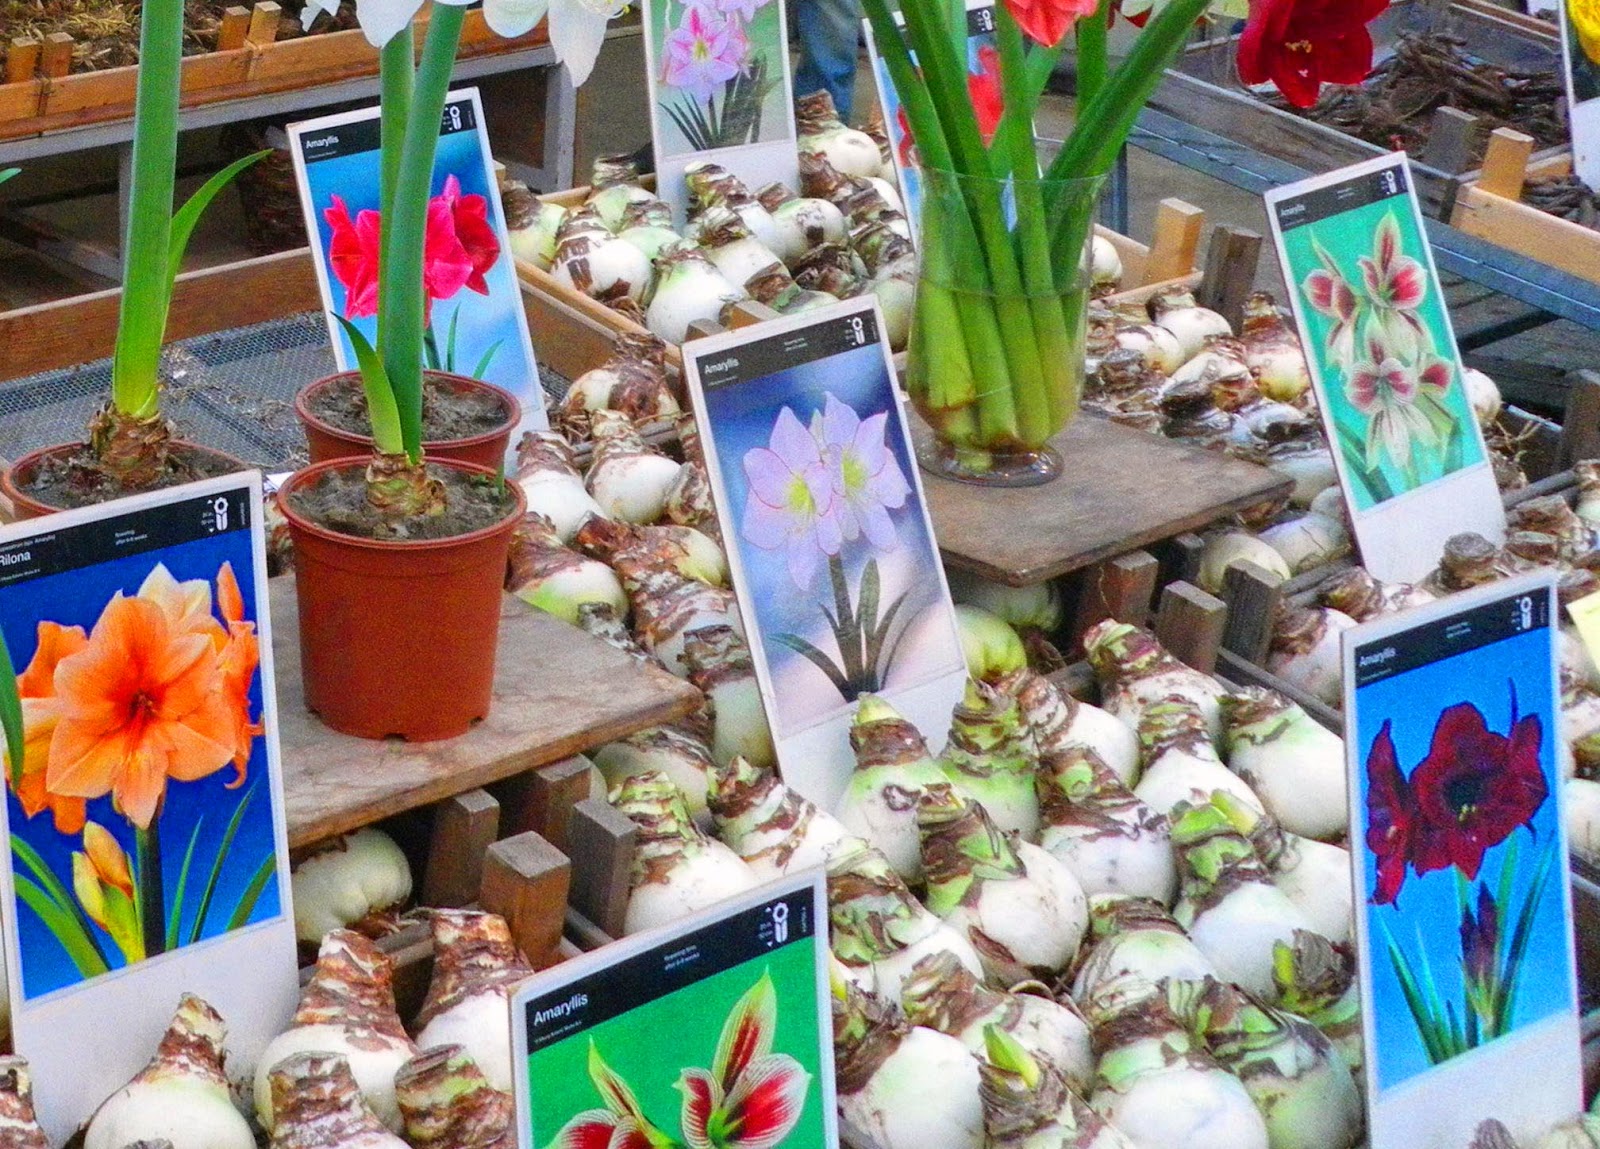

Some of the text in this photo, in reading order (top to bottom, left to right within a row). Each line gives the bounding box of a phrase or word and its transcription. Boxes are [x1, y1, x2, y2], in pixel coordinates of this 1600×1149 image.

[306, 135, 339, 149] Amaryllis
[0, 551, 31, 567] Rilona
[534, 993, 588, 1027] Amaryllis
